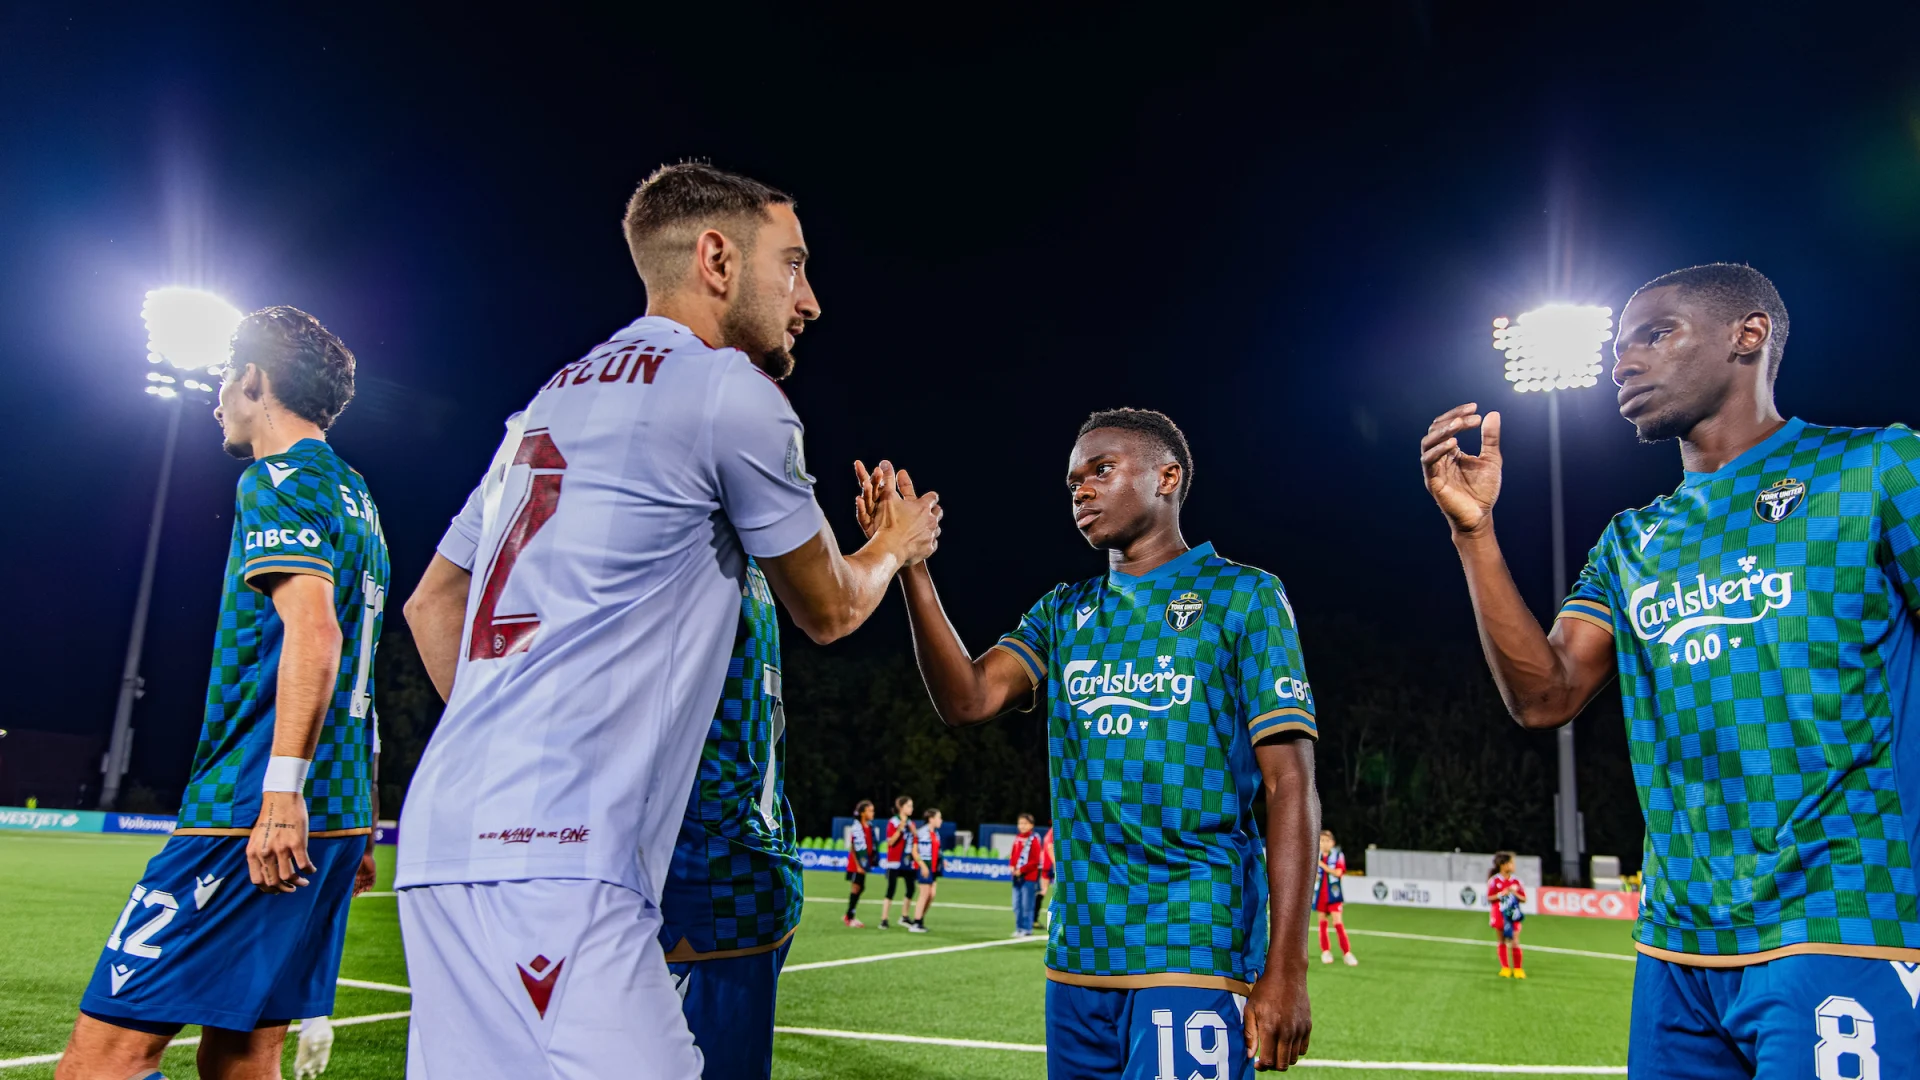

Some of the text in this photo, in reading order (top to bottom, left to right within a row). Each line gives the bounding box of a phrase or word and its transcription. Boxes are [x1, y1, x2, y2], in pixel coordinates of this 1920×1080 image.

[1760, 486, 1803, 501] YORK UNITED
[245, 528, 298, 551] CIBC
[465, 426, 568, 662] 2
[1629, 569, 1793, 645] Carlsberg
[1684, 633, 1721, 665] 0.0
[1063, 659, 1195, 714] Carlsberg
[1097, 713, 1133, 736] 0.0
[558, 825, 590, 844] ONE
[106, 883, 179, 959] 12
[1542, 890, 1599, 914] CIBC
[1151, 1008, 1229, 1080] 19
[1814, 995, 1880, 1080] 8
